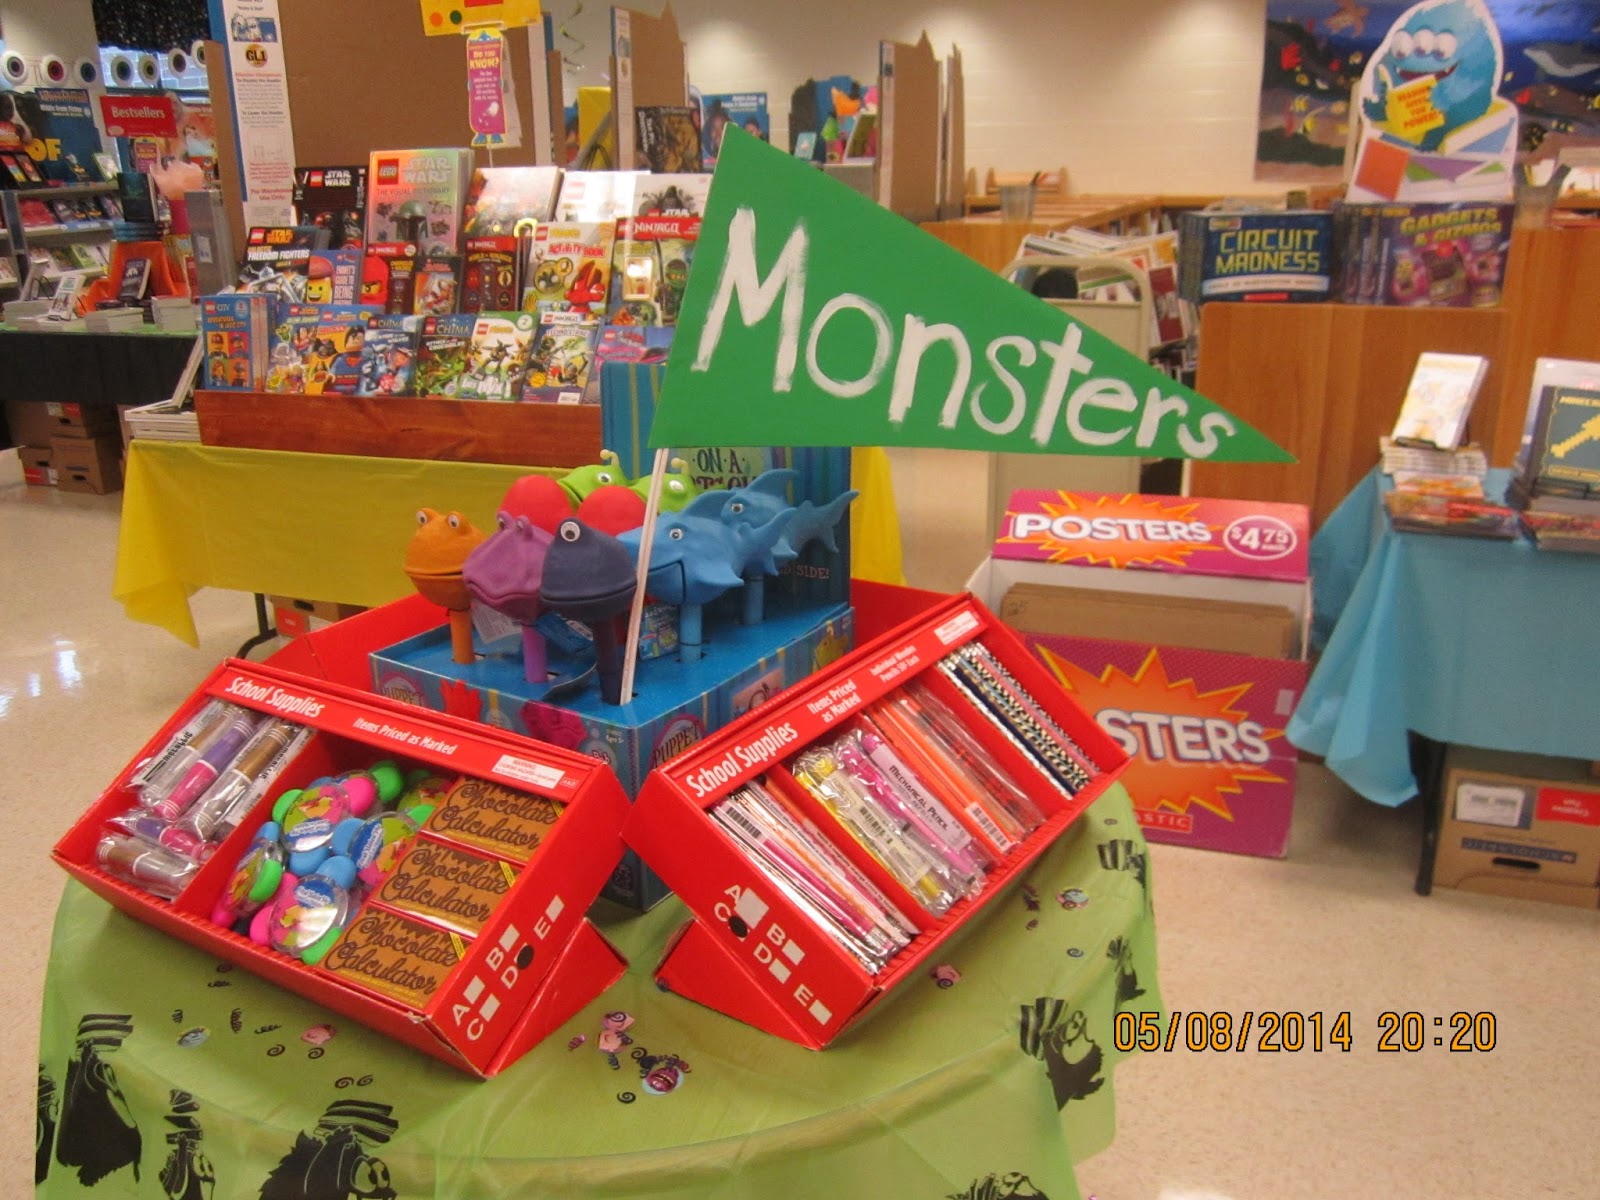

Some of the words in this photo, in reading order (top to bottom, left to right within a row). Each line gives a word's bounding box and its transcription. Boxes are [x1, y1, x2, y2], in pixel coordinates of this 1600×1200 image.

[111, 106, 166, 119] Bestsellers
[325, 170, 351, 178] STAR
[379, 166, 397, 177] LEGO
[408, 157, 450, 170] STAR
[325, 178, 351, 187] WARS
[404, 170, 451, 183] WARS
[634, 222, 680, 235] NINJAGO
[1220, 229, 1319, 253] CIRCUIT
[280, 249, 310, 260] FIGHTERS
[1215, 251, 1321, 275] MADNESS
[437, 323, 471, 334] CHIMA
[690, 206, 1236, 459] Monsters
[697, 448, 723, 473] ON
[729, 449, 744, 474] A
[1013, 512, 1214, 543] POSTERS
[226, 676, 275, 704] School
[269, 687, 325, 718] Supplies
[806, 695, 834, 715] Items
[829, 678, 857, 701] Priced
[821, 711, 834, 723] as
[829, 691, 862, 717] Marked
[353, 717, 380, 734] Items
[377, 724, 407, 743] Priced
[407, 734, 419, 745] as
[419, 734, 458, 756] Marked
[1096, 708, 1272, 765] STERS
[686, 752, 742, 798] School
[735, 721, 799, 770] Supplies
[448, 778, 559, 826] Chocolate
[430, 804, 540, 850] Calculator
[1135, 812, 1189, 828] STIC
[399, 846, 509, 895] Chocolate
[380, 874, 491, 922] Calculator
[724, 884, 742, 904] A
[714, 902, 731, 923] C
[346, 914, 459, 967] Chocolate
[533, 917, 551, 940] E
[766, 923, 787, 947] B
[485, 947, 505, 972] B
[753, 943, 774, 965] D
[324, 942, 438, 996] Calculator
[501, 967, 519, 989] D
[793, 983, 814, 1006] E
[452, 1003, 471, 1026] A
[466, 1018, 485, 1041] C
